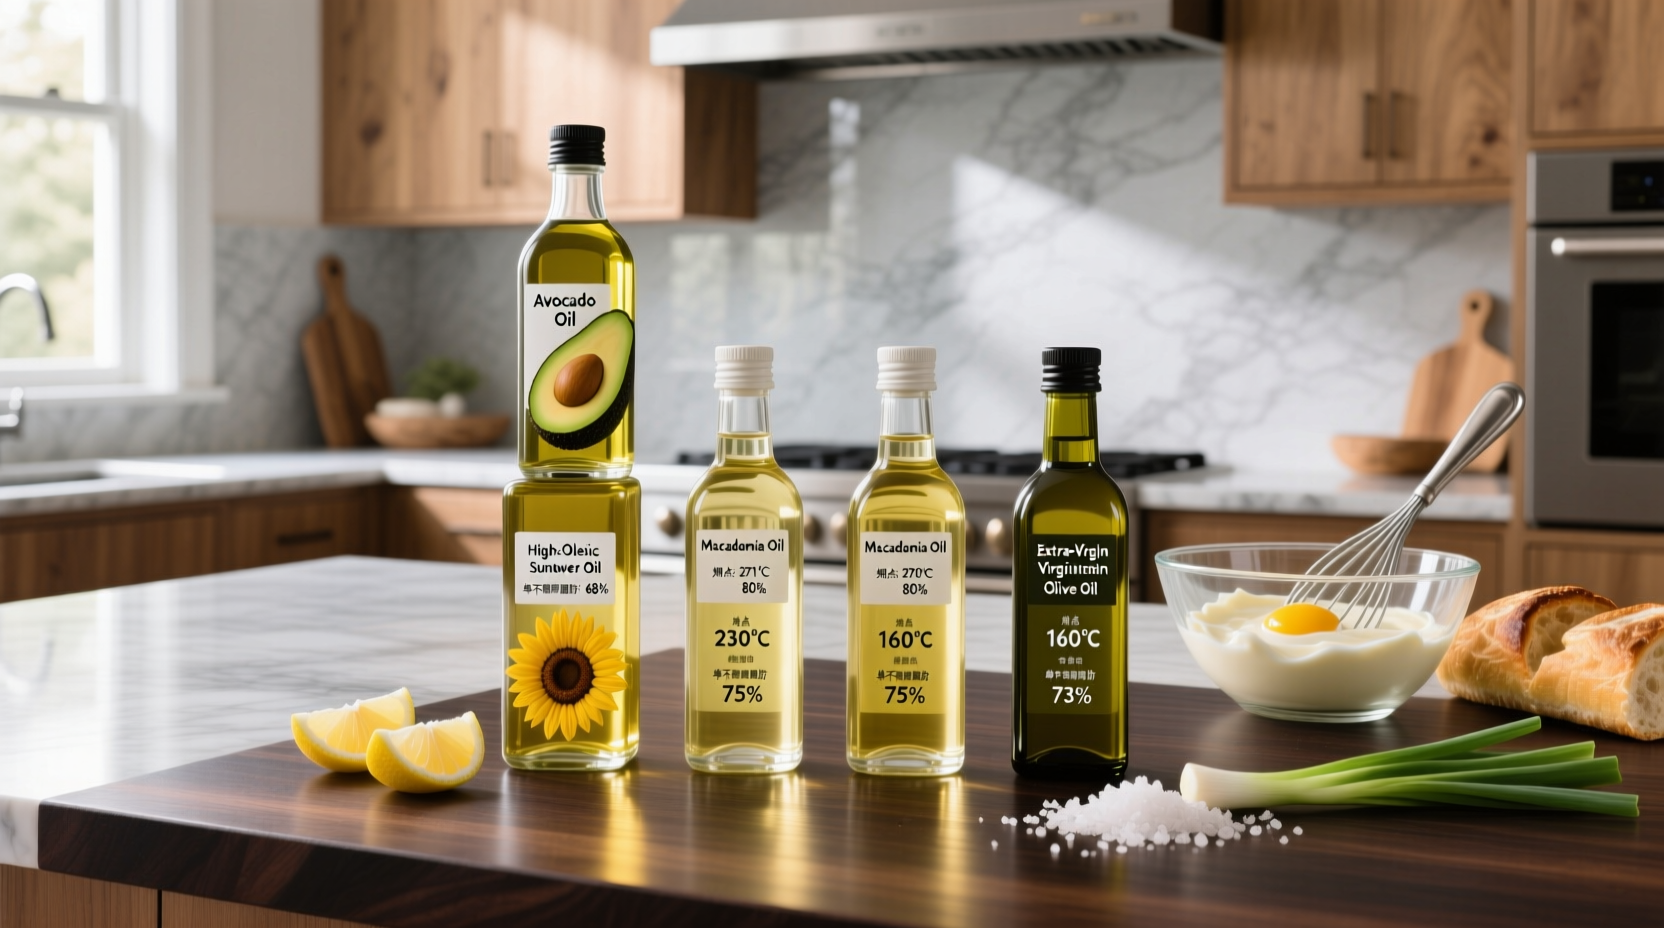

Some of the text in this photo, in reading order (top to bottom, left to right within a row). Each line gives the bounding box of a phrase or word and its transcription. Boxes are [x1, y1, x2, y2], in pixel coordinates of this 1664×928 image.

[533, 292, 597, 308] Avocado
[554, 311, 576, 327] Oil
[767, 538, 785, 552] Oil
[583, 561, 602, 574] Oil
[1043, 580, 1098, 596] Olive Oil
[1046, 628, 1101, 648] 160°C
[722, 684, 763, 704] 75%
[884, 685, 926, 705] 75%
[1051, 685, 1093, 705] 73%
